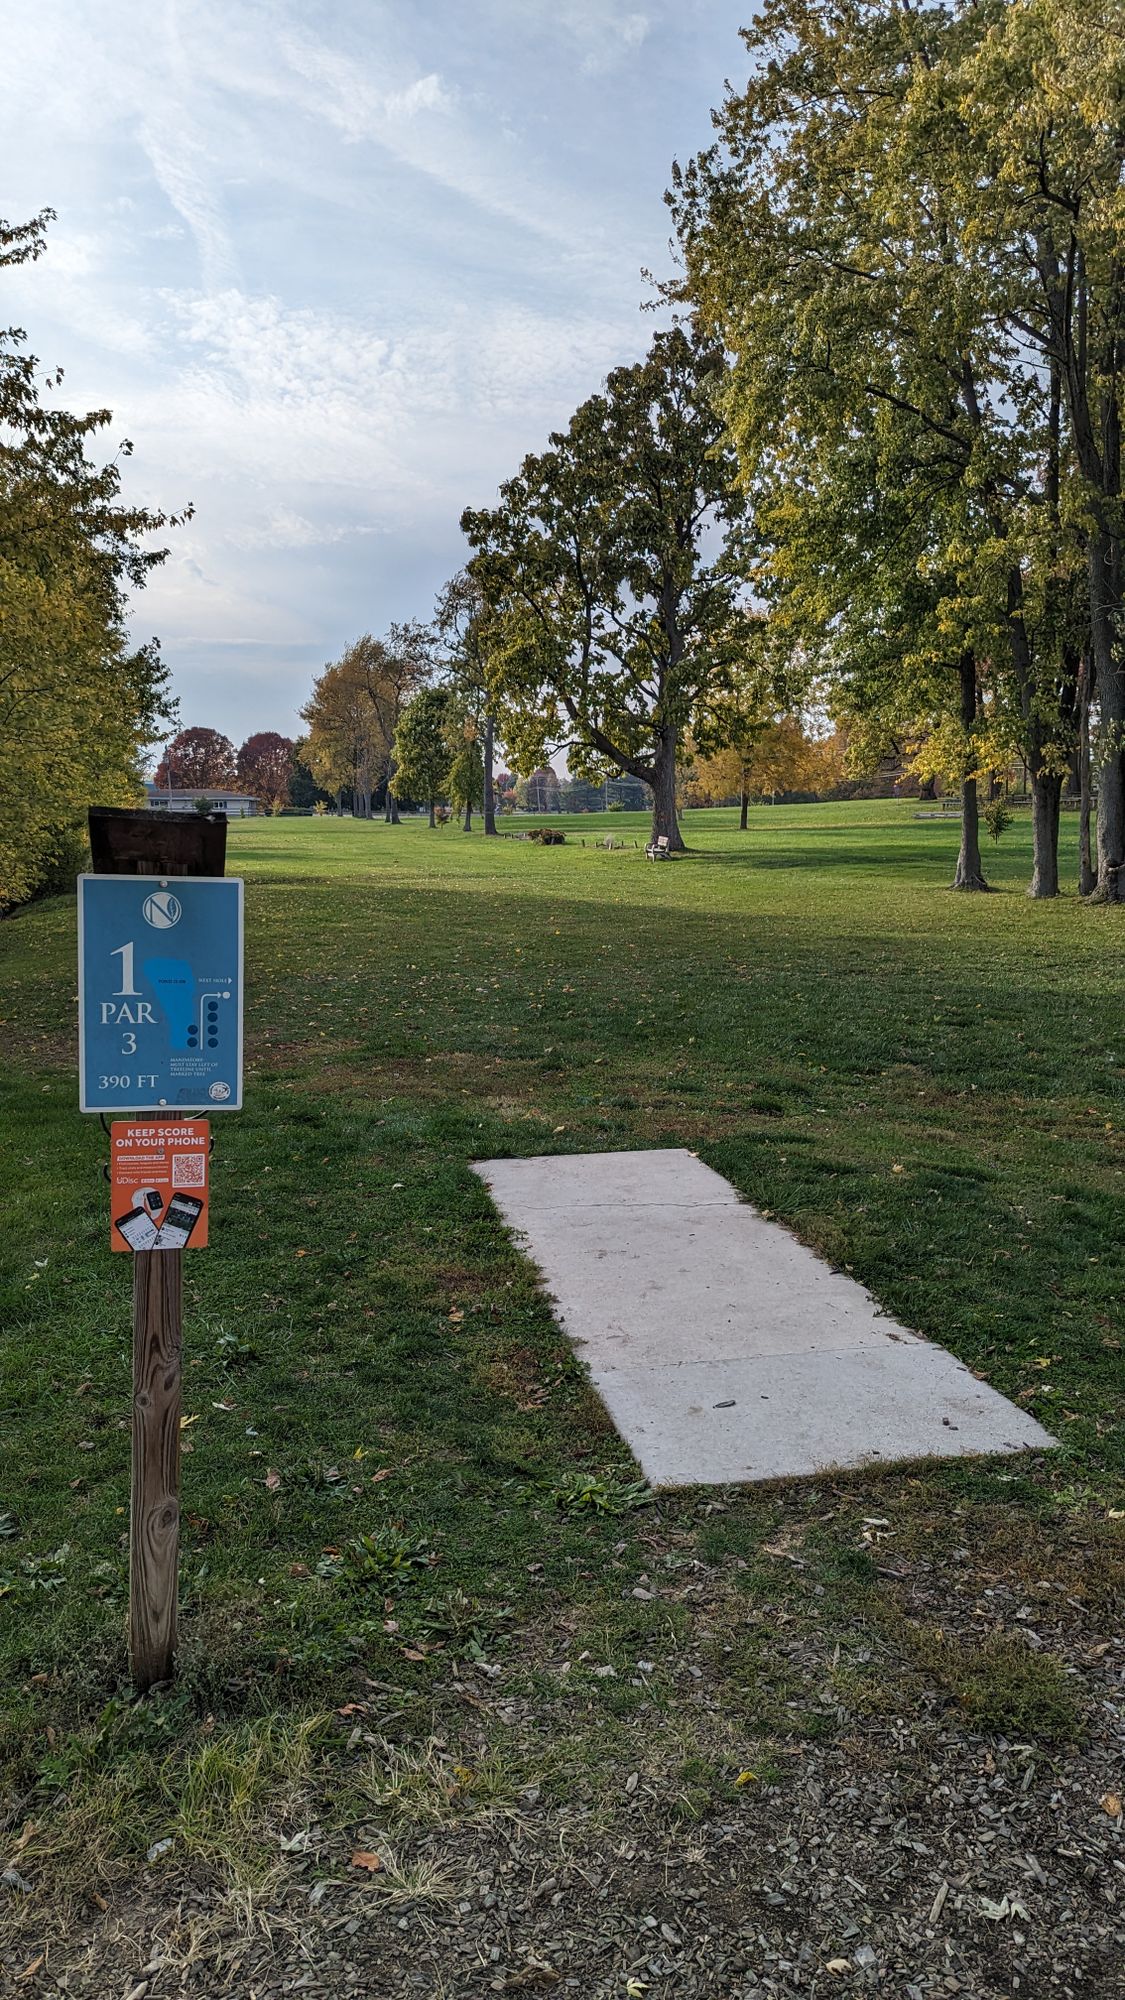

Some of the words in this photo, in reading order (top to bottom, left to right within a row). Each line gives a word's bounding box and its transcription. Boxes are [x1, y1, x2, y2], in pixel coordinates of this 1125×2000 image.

[110, 941, 143, 996] 1
[99, 1002, 159, 1025] PAR
[121, 1032, 137, 1055] 3
[98, 1075, 130, 1089] 390
[137, 1075, 160, 1089] FT
[127, 1128, 155, 1137] KEEP
[157, 1127, 194, 1136] SCORE
[116, 1138, 133, 1147] ON
[135, 1138, 165, 1147] YOUR
[167, 1137, 206, 1146] PHONE
[116, 1176, 139, 1184] UDisc
